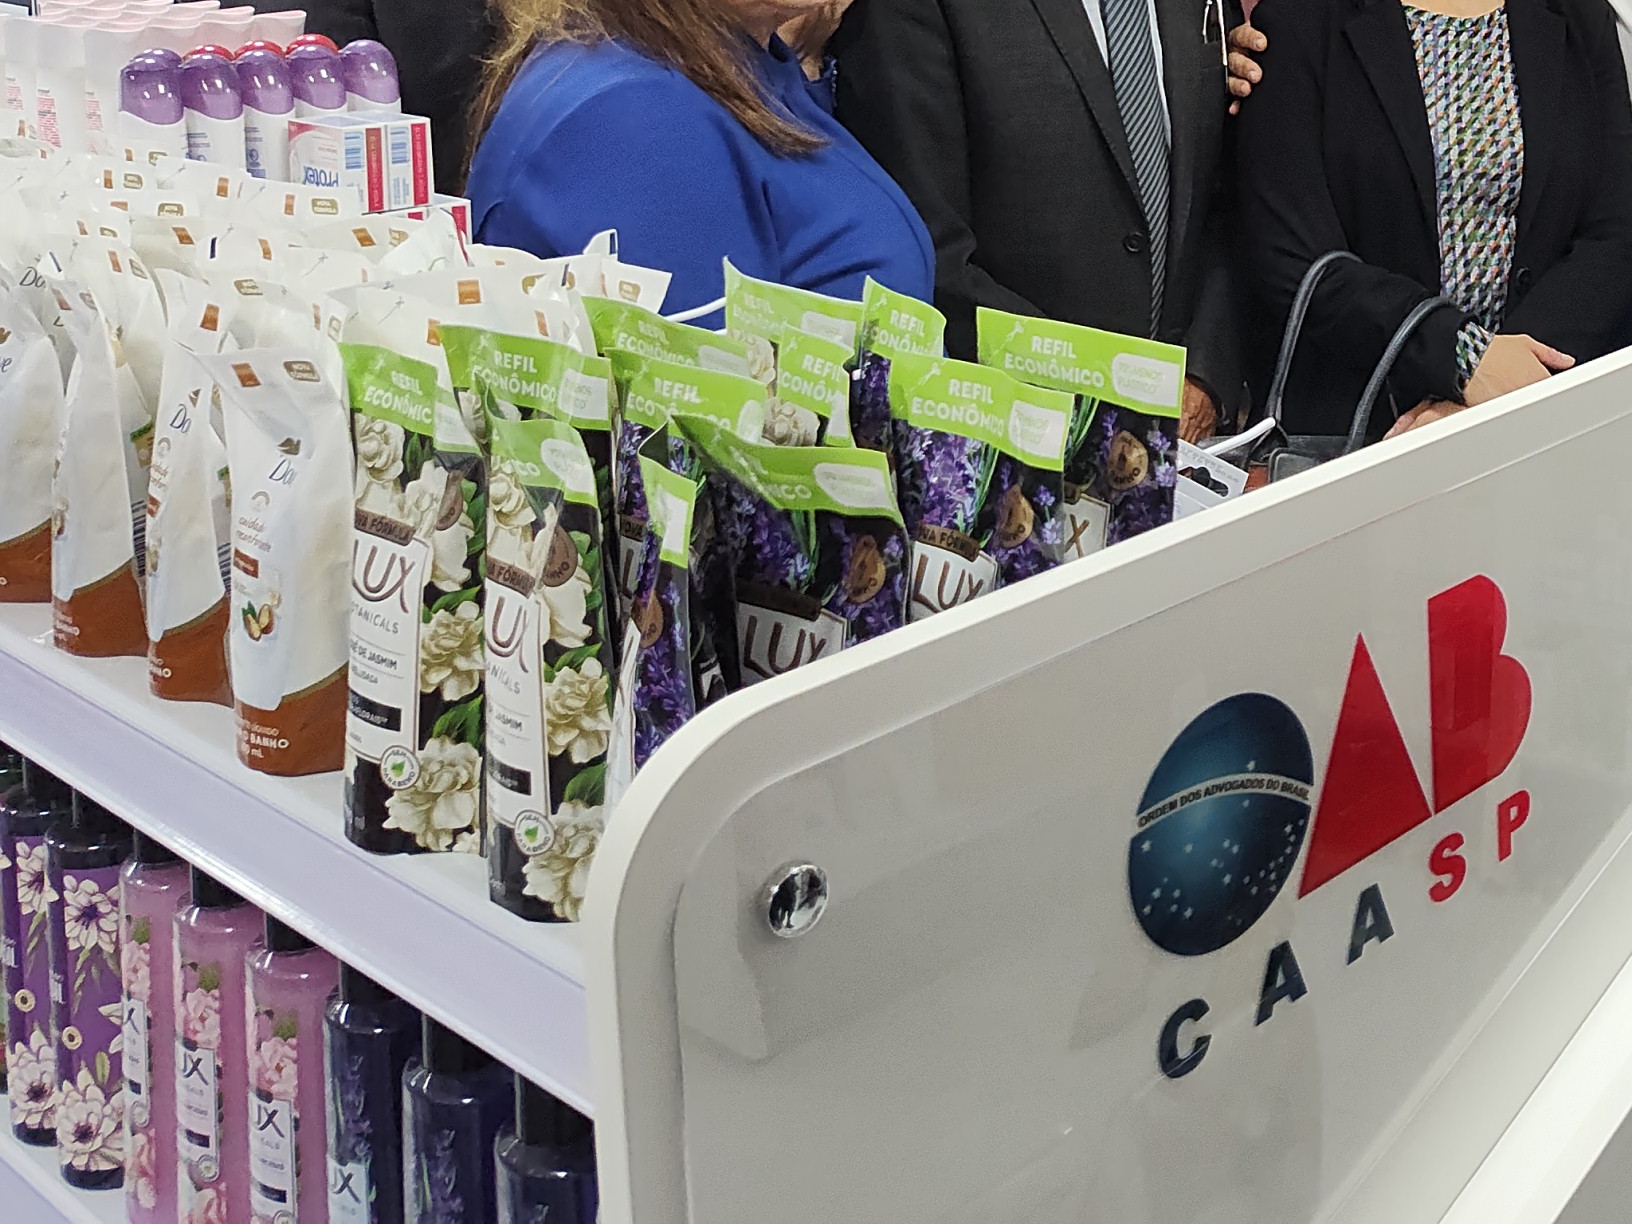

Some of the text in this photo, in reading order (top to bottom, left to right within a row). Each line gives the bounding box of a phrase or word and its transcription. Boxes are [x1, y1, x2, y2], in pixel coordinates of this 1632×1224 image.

[890, 309, 925, 337] REFIL
[493, 350, 538, 373] REFIL
[1031, 336, 1076, 359] REFIL
[1004, 353, 1105, 388] ECONÔMICO
[363, 385, 433, 424] ECONÔMIC
[949, 378, 993, 404] REFIL
[912, 552, 984, 614] LUX
[743, 614, 827, 678] LUX
[1138, 778, 1309, 828] ORDEM DOS ADVOGADOS DO BRASIL
